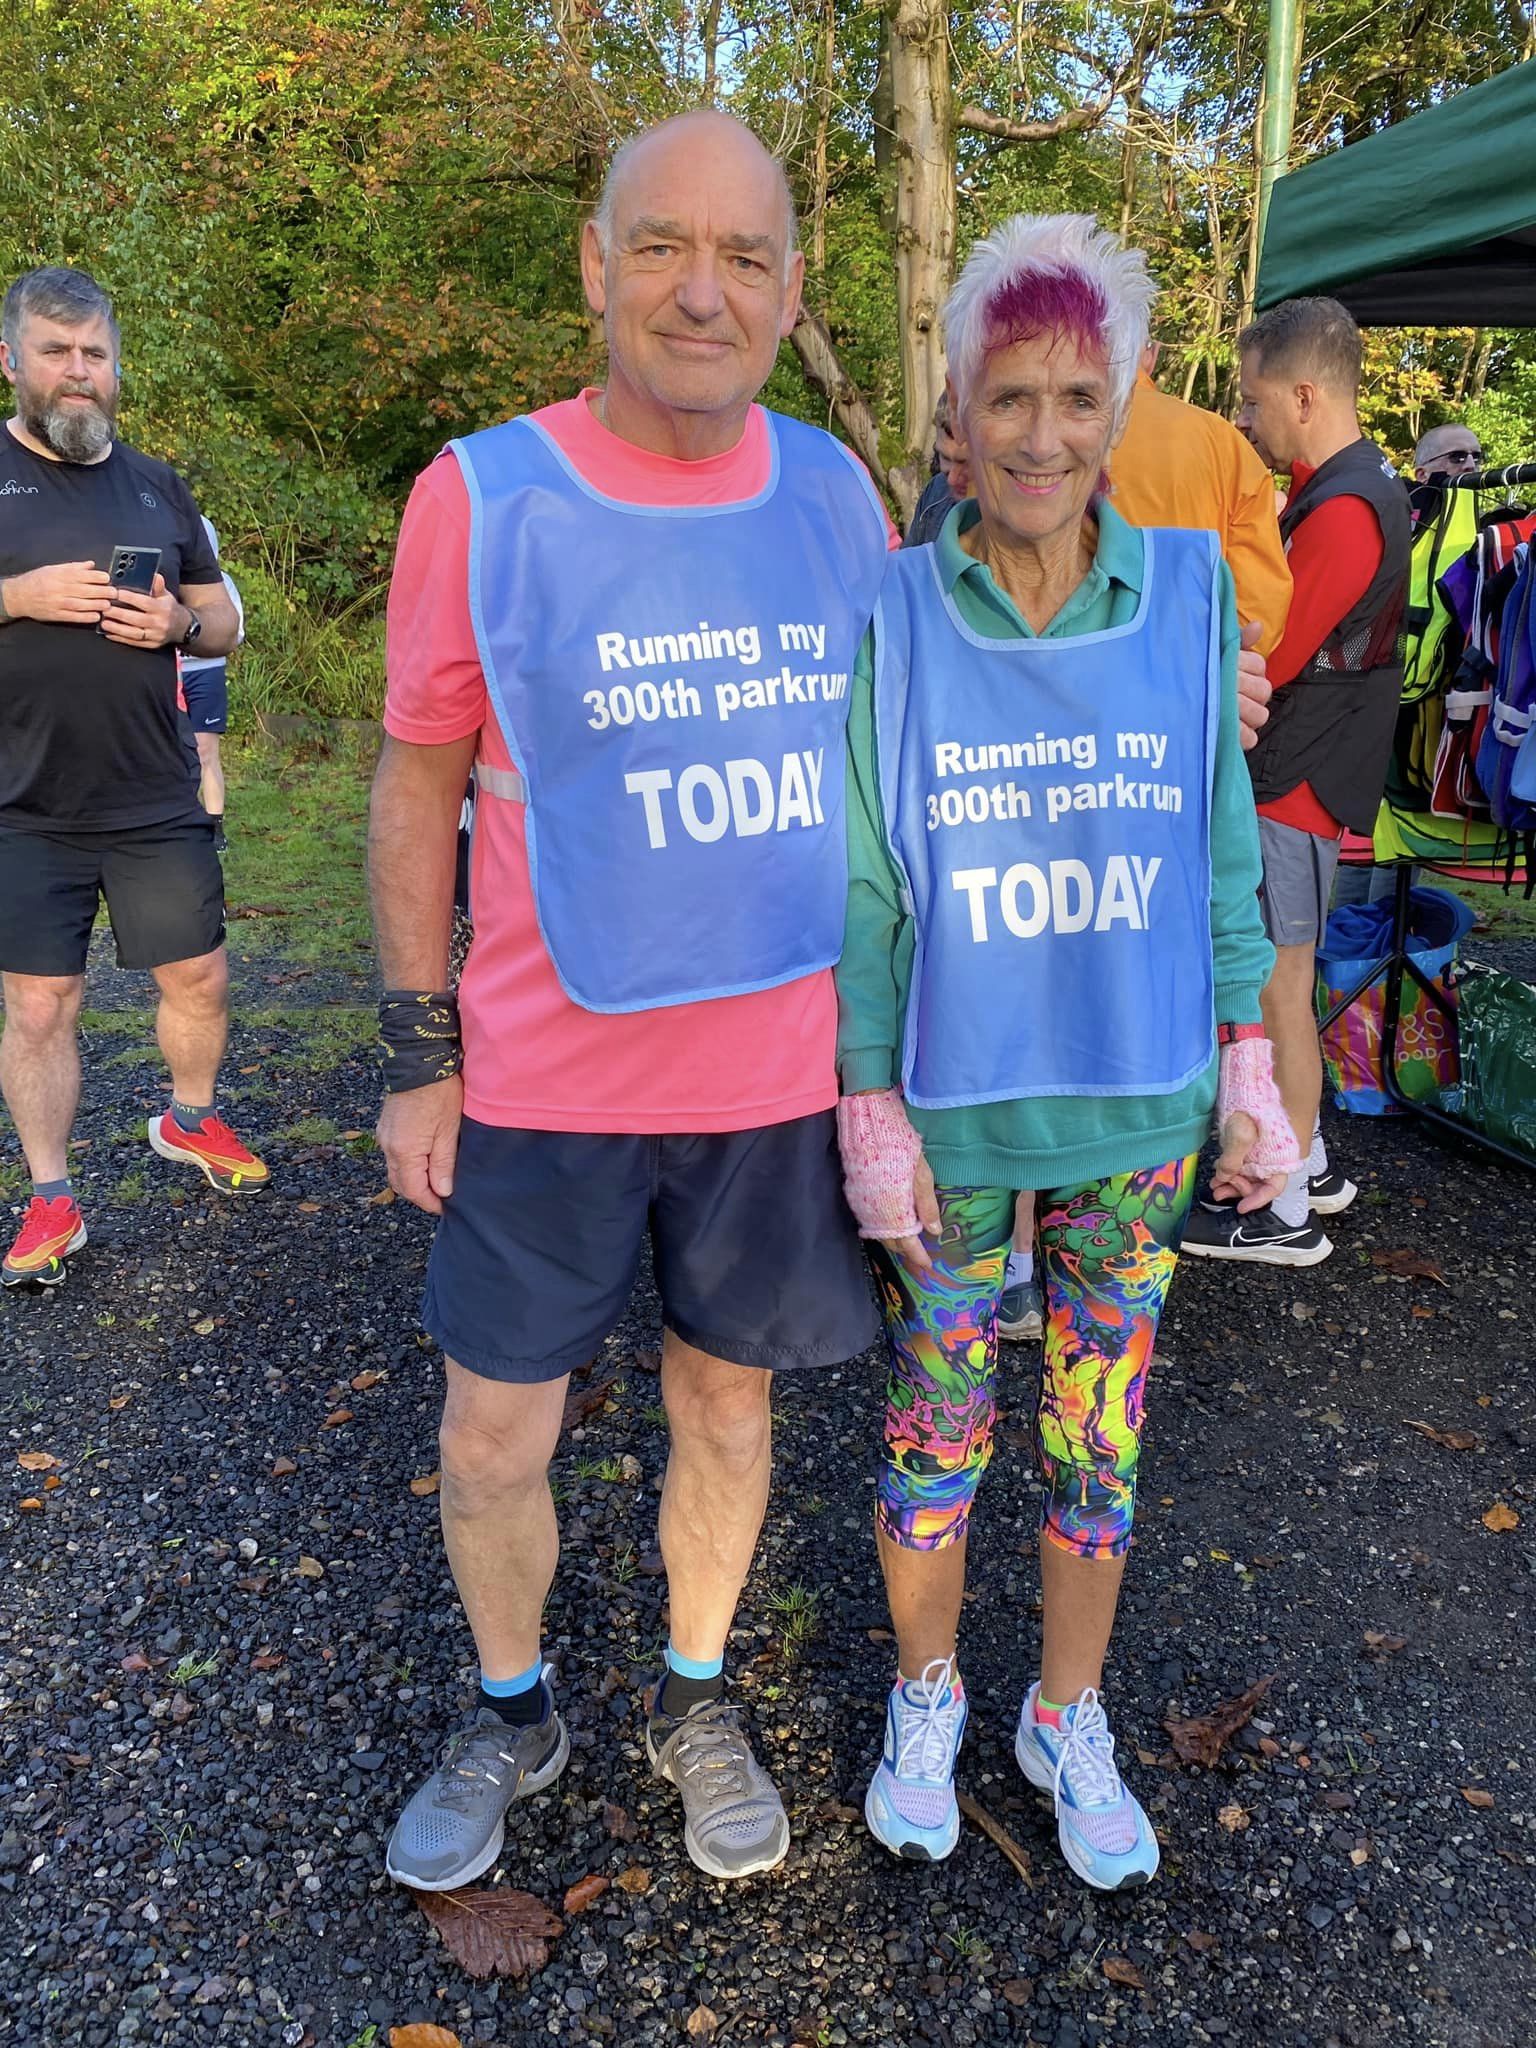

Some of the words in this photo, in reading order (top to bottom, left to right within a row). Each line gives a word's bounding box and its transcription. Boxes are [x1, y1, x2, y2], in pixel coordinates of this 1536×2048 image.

[0, 480, 39, 496] arkrun
[596, 621, 762, 673] Running
[778, 623, 826, 660] my
[582, 677, 702, 730] 300th
[714, 666, 848, 722] parkrun
[935, 732, 1097, 777] Running
[1116, 732, 1168, 769] my
[624, 748, 825, 849] TODAY
[926, 782, 1032, 831] 300th
[1046, 773, 1183, 823] parkrun
[951, 855, 1163, 944] TODAY
[1396, 1047, 1437, 1063] OOD
